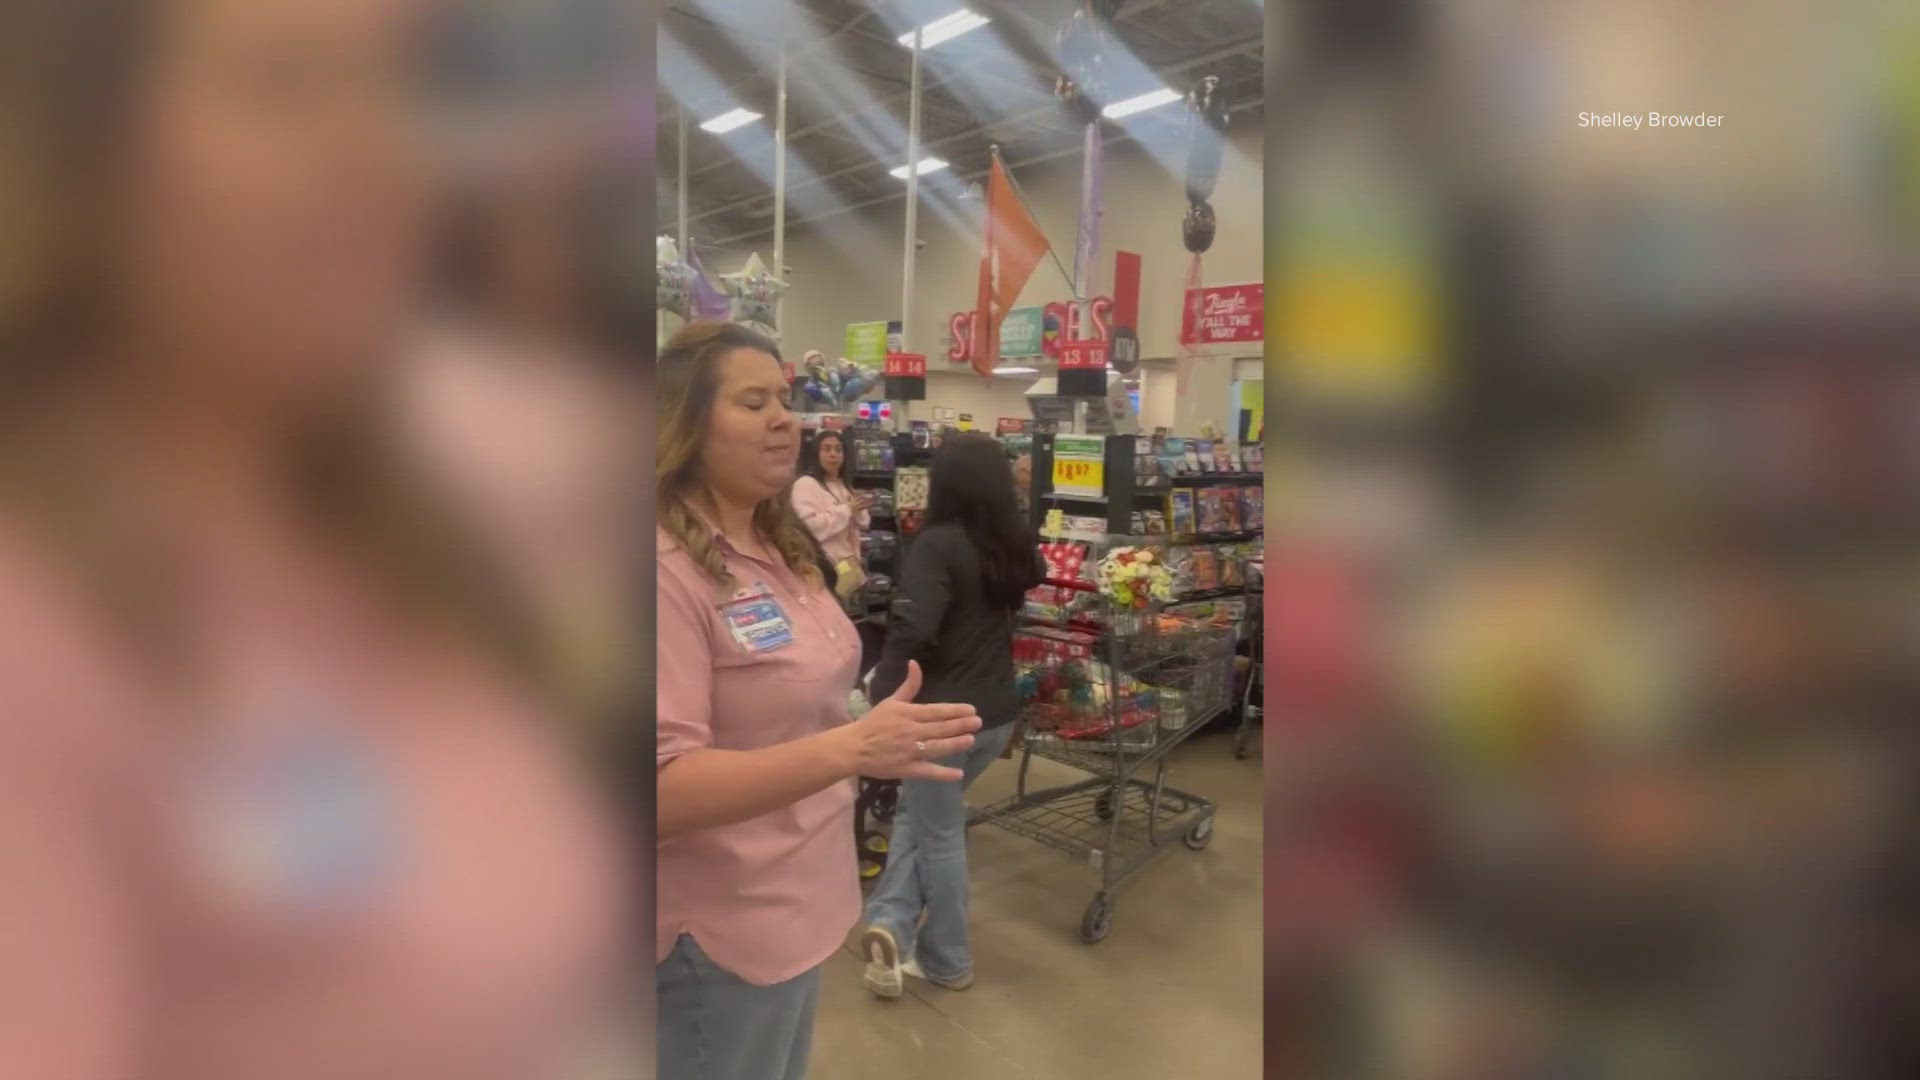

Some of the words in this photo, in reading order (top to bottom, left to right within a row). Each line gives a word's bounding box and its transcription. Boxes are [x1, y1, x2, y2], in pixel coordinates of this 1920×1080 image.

[1229, 314, 1251, 327] THE
[1210, 327, 1238, 339] WAY
[1063, 348, 1081, 366] 13
[1089, 348, 1105, 366] 13
[888, 359, 901, 374] 14
[907, 360, 923, 375] 14
